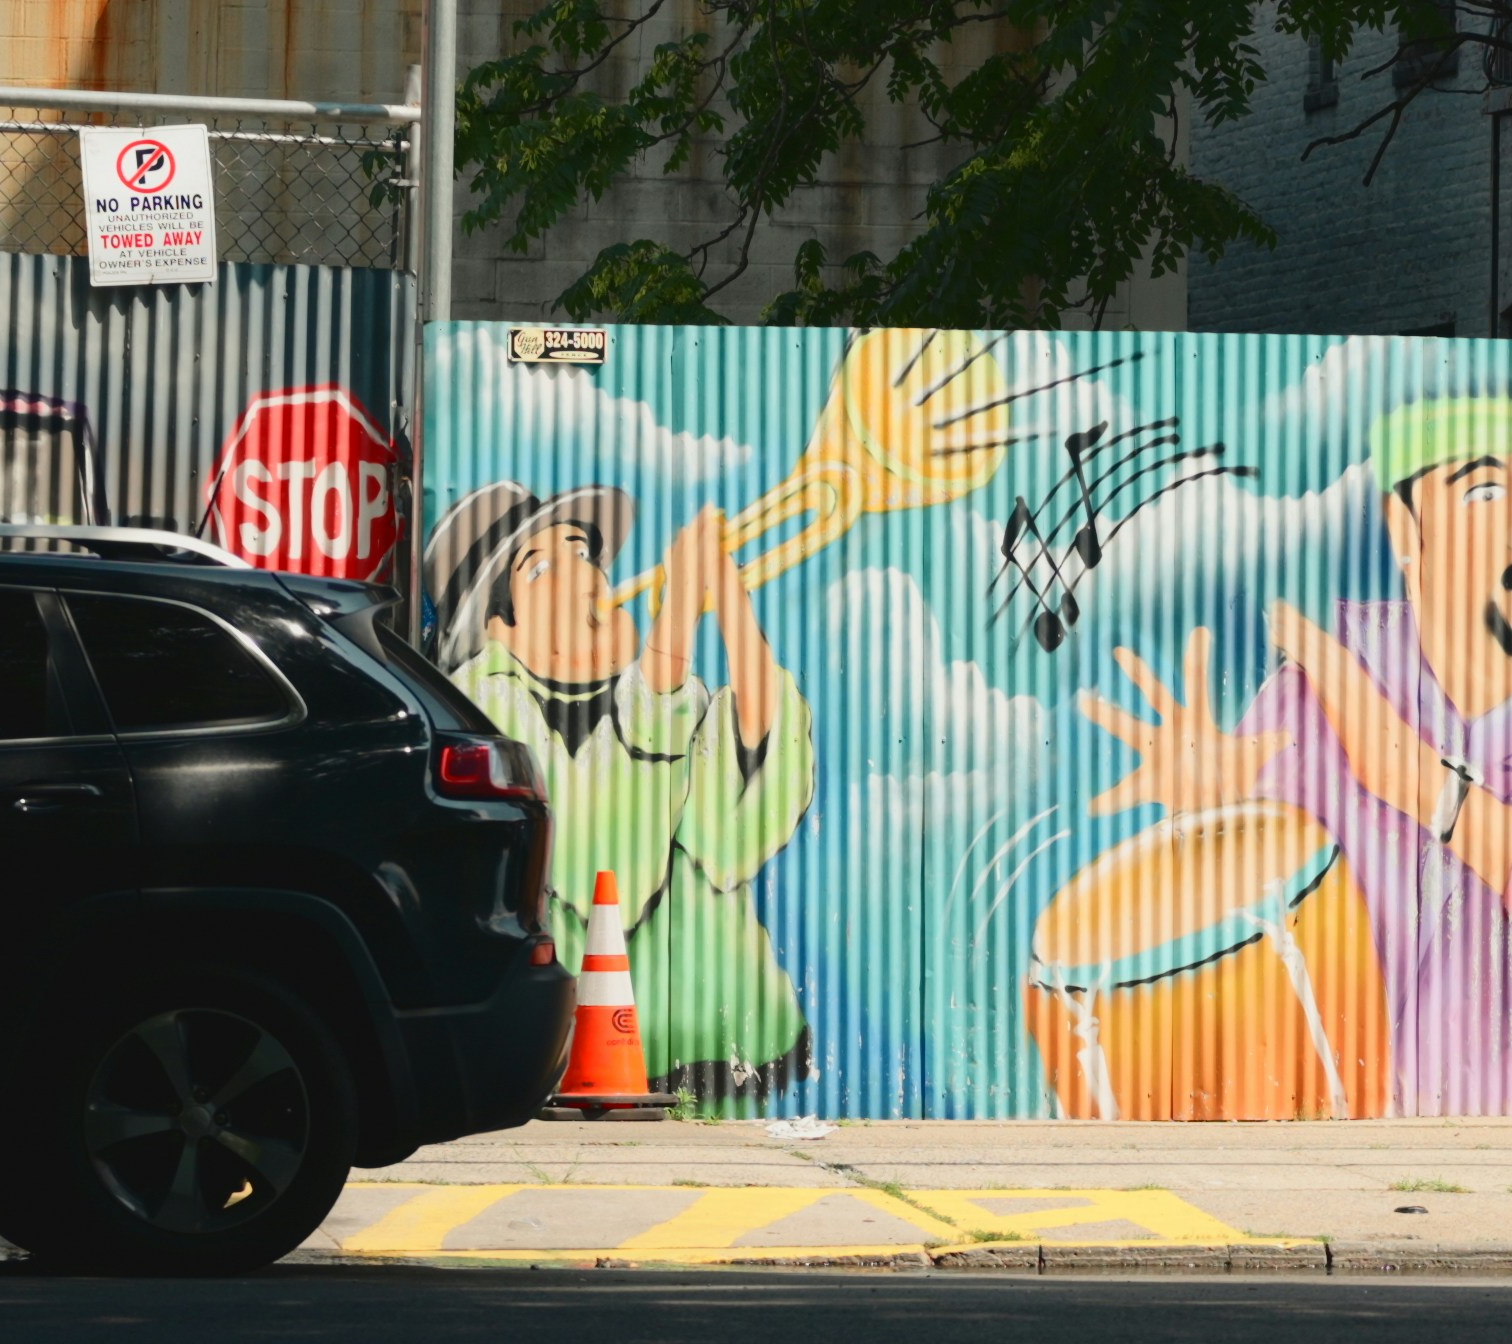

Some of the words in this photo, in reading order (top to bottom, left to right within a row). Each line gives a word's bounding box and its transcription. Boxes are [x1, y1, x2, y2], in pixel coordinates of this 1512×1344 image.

[96, 198, 119, 213] NO
[130, 194, 204, 212] PARKING
[108, 211, 194, 223] UNAUTHORIZED
[98, 222, 154, 233] VEHICLES
[157, 222, 185, 231] WILL
[189, 221, 204, 229] BE
[100, 233, 154, 249] TOWED
[163, 231, 203, 247] AWAY
[119, 250, 134, 258] AT
[138, 248, 187, 257] VEHICLE
[99, 258, 153, 269] OWNER'S
[155, 257, 208, 267] EXPENSE
[545, 331, 604, 349] 324-5000
[232, 457, 389, 560] STOP
